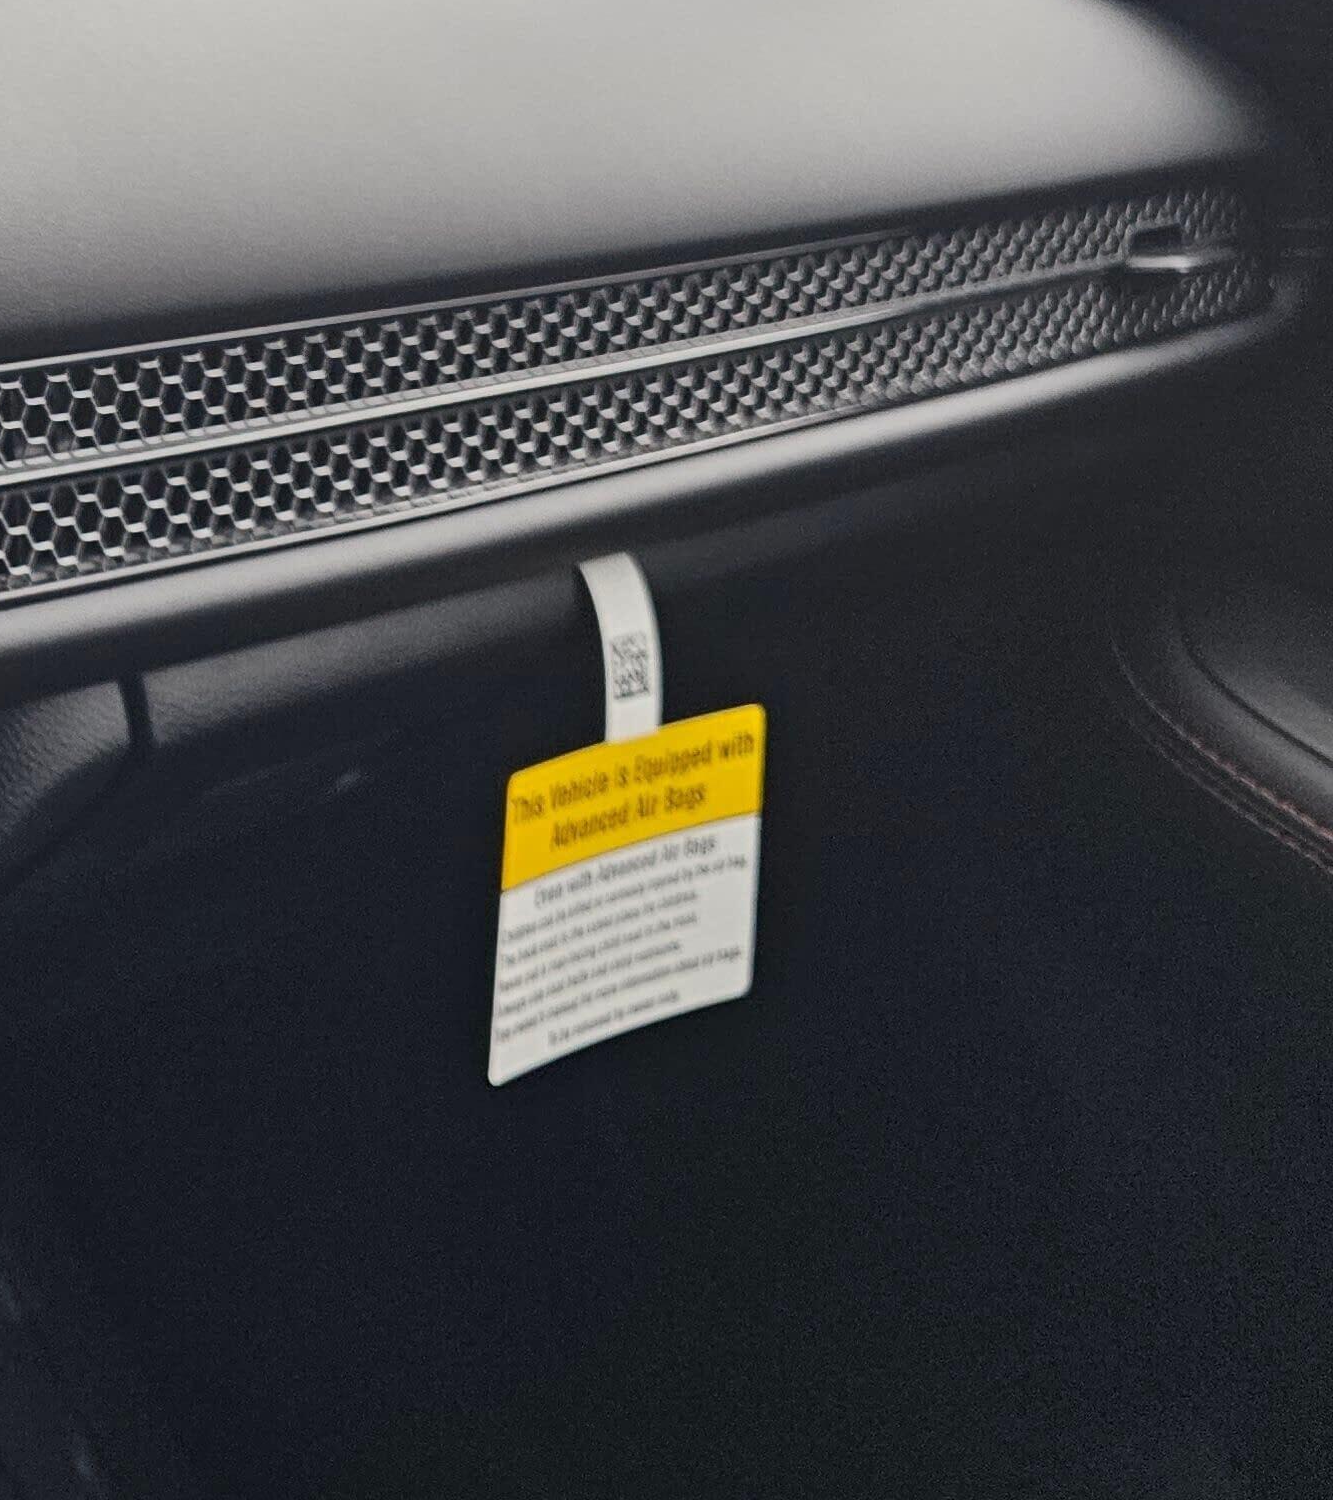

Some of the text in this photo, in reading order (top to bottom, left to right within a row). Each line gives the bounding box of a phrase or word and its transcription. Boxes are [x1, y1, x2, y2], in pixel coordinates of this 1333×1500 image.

[549, 771, 610, 810] Vehicle
[634, 740, 713, 783] Equipped
[718, 731, 755, 761] with
[550, 802, 629, 849] Advanced
